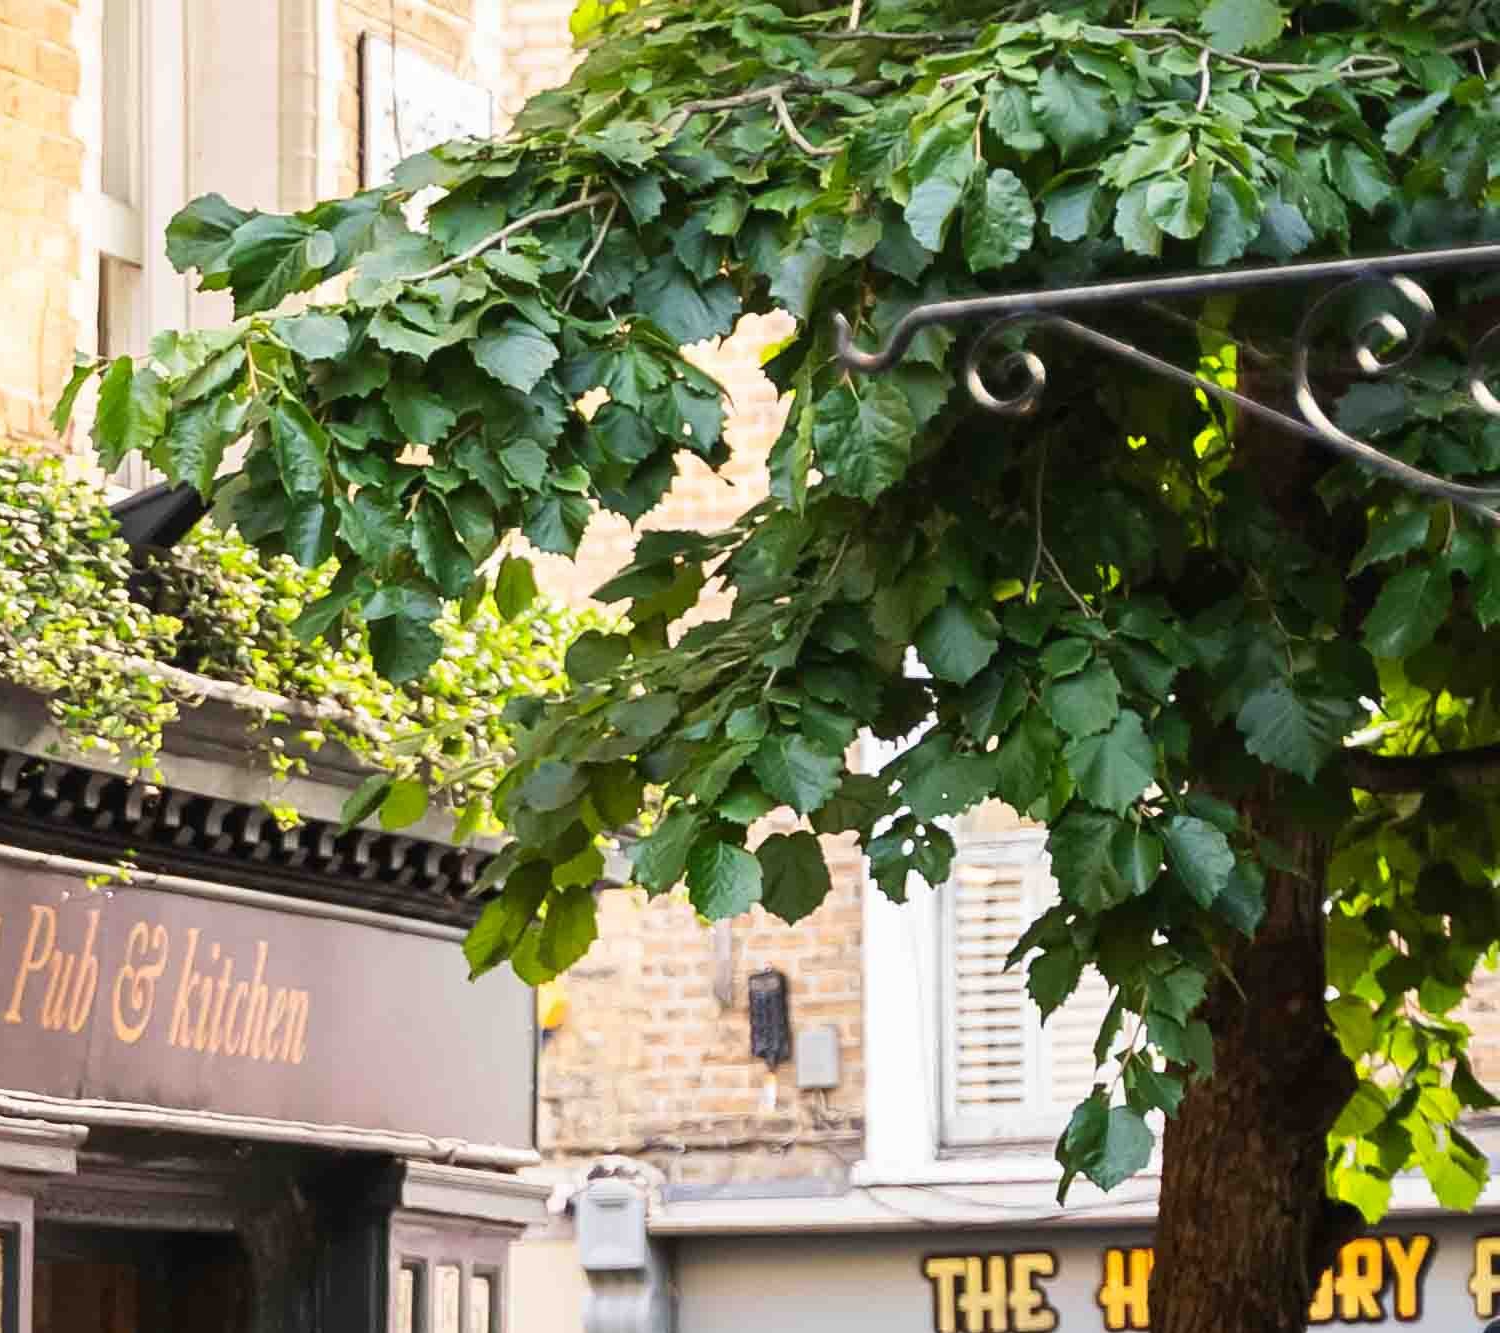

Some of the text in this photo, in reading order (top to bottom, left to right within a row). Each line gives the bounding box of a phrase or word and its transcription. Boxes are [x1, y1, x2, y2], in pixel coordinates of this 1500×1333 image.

[3, 903, 100, 1035] Pub
[110, 920, 169, 1044] &
[167, 926, 311, 1066] kitchen
